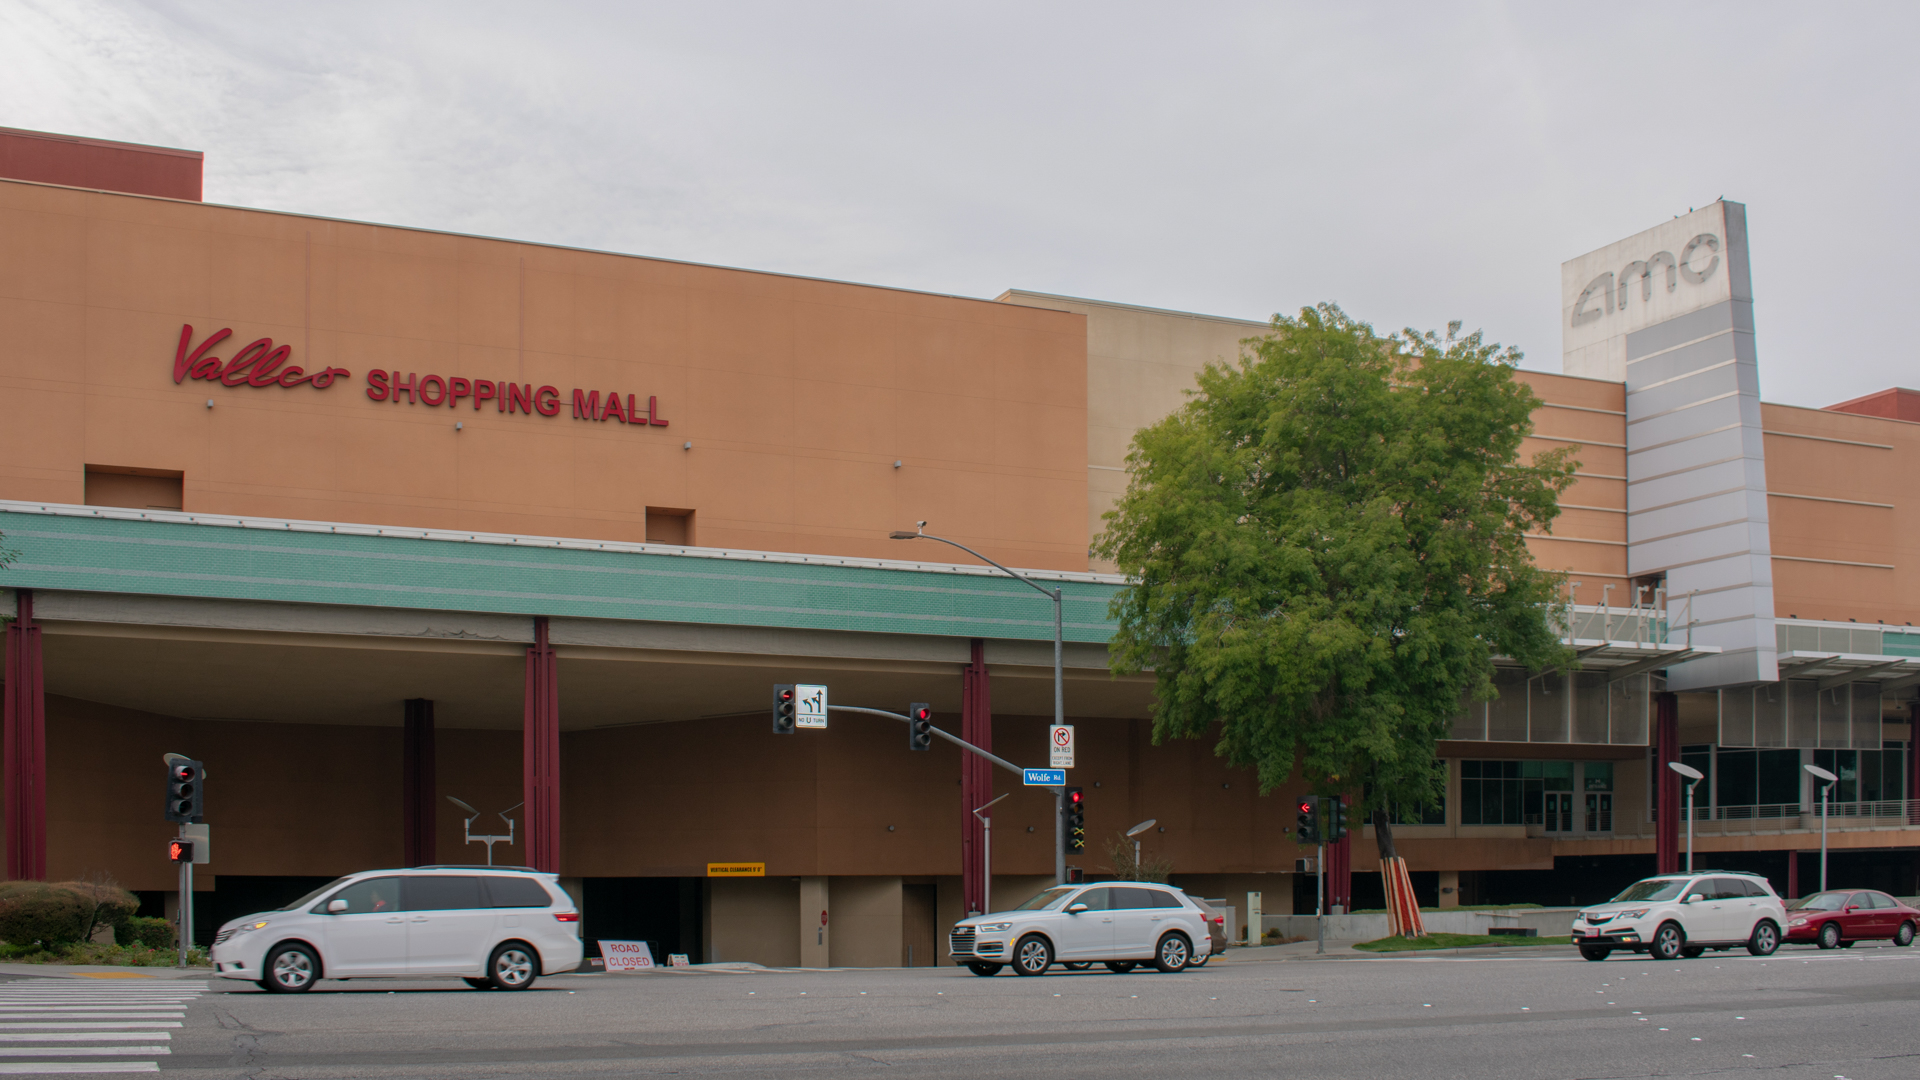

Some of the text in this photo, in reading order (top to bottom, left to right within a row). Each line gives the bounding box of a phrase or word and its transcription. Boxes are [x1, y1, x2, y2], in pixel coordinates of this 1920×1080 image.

[173, 324, 669, 427] Vallco SHOPPING MALL
[806, 716, 812, 724] U
[1028, 773, 1050, 782] Wolfe
[610, 944, 640, 953] ROAD
[609, 956, 650, 967] CLOSED
